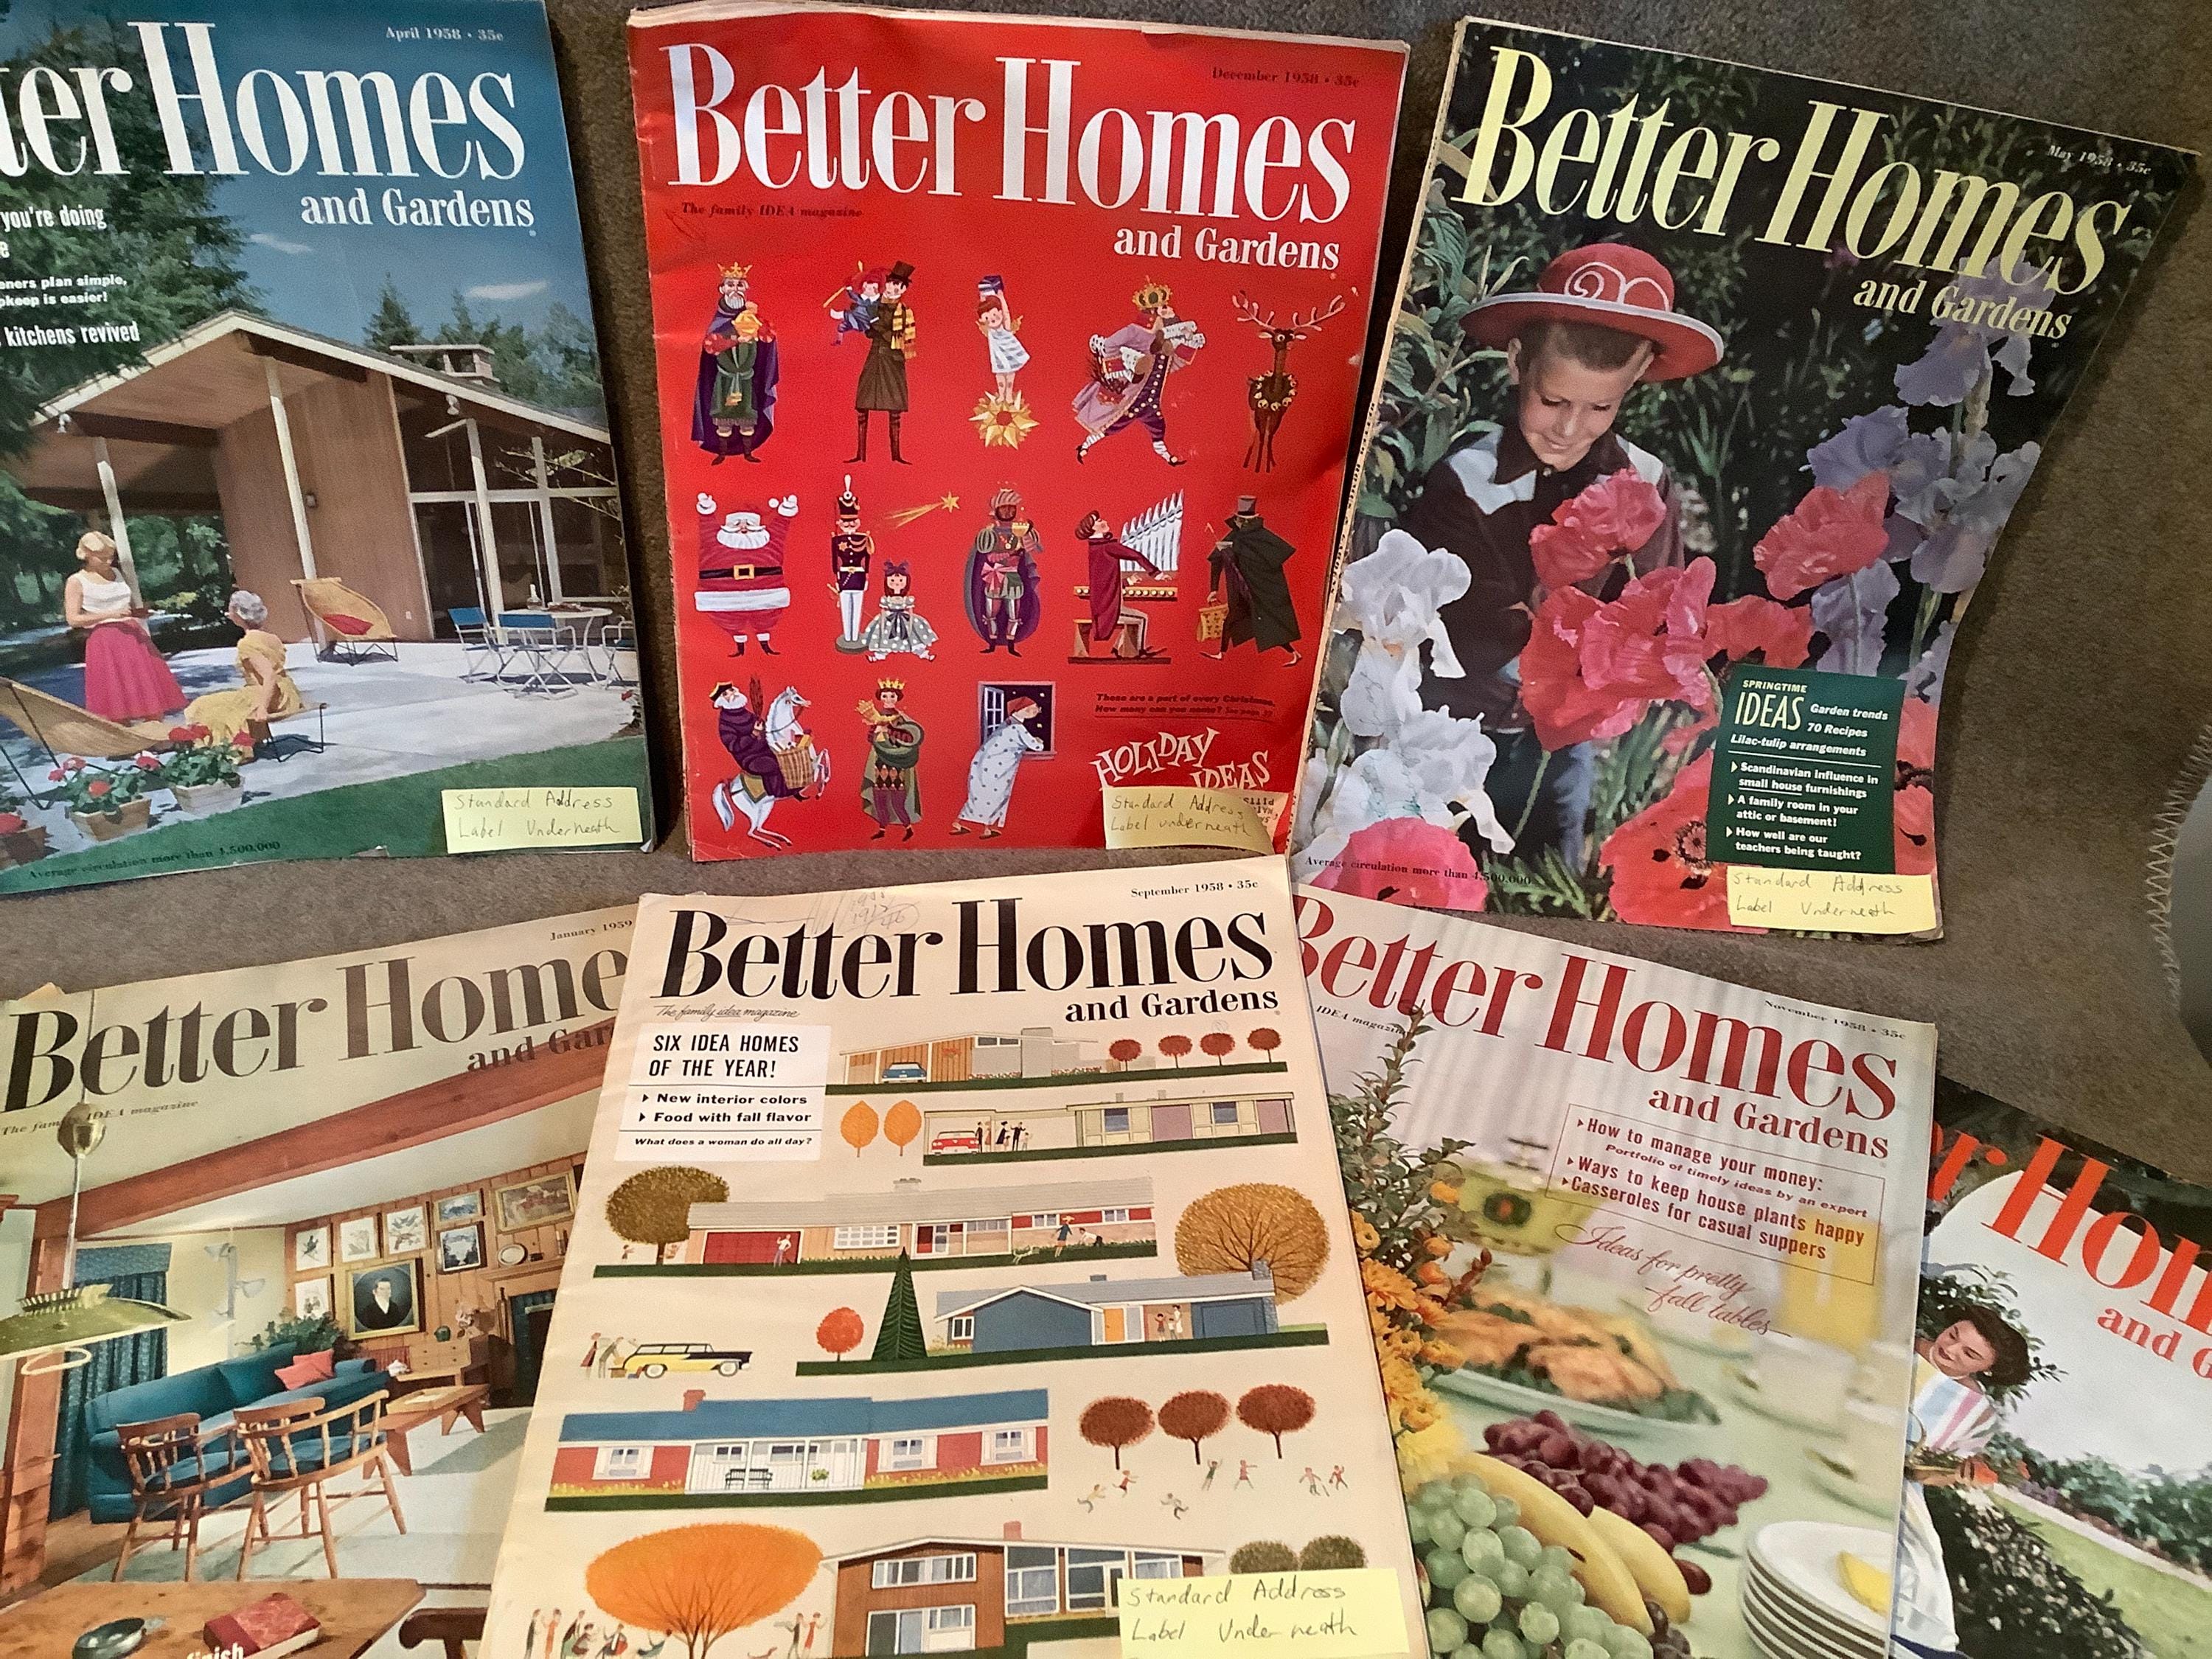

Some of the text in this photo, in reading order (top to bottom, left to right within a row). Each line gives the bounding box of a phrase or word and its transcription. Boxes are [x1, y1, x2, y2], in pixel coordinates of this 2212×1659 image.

[386, 27, 462, 42] April 1958
[1212, 67, 1279, 82] December
[127, 21, 526, 180] Homes
[659, 43, 986, 196] Better
[992, 56, 1356, 223] Homes
[1450, 46, 1781, 236] Better
[1754, 100, 2132, 295] Homes
[0, 204, 107, 232] you're doing
[301, 188, 535, 228] and Gardens
[682, 202, 863, 218] The family IDEA magazine
[1113, 225, 1340, 271] and Gardens
[41, 274, 128, 290] plan simple,
[44, 291, 108, 305] is easier!
[1853, 277, 2072, 341] and Gardens
[4, 321, 140, 347] kitchens revived
[1096, 693, 1220, 703] These every
[1742, 680, 1807, 694] SPRINGTIME
[1095, 704, 1222, 714] How many name?
[1734, 692, 1804, 731] IDEAS
[1810, 703, 1888, 720] Garden trends
[1807, 723, 1868, 738] 70 Recipes
[1731, 734, 1867, 757] Lilac-tulip arrangements
[1090, 726, 1220, 791] HOLIDAY
[1189, 750, 1271, 789] IDEAS
[1740, 762, 1879, 785] Scandinavian influence in
[454, 790, 613, 810] Standard Address
[1739, 778, 1867, 799] small house furnishings
[1111, 793, 1174, 810] Standard
[1189, 794, 1244, 819] Address
[1737, 796, 1859, 816] A family room in your
[458, 815, 620, 838] Label Underneath
[1111, 817, 1148, 832] Label
[1736, 810, 1837, 827] attic or basement!
[1736, 827, 1828, 844] How well are our
[81, 849, 213, 874] circulation more than
[1736, 841, 1862, 861] teachers being taught?
[1305, 856, 1468, 880] Average circulation more than
[1131, 883, 1224, 900] September 1958
[1733, 872, 1902, 896] Standard Address
[1736, 894, 1772, 913] Label
[550, 920, 632, 941] January 1959
[650, 897, 1273, 1000] Better Homes
[653, 1004, 800, 1022] The family idea magazine
[1065, 990, 1279, 1022] and Gardens
[1293, 894, 1896, 1121] Better Homes
[1316, 1006, 1349, 1020] IDEA
[1765, 1000, 1866, 1032] November 1958
[2, 997, 327, 1113] Better
[467, 1036, 536, 1071] and
[653, 1034, 799, 1053] SIX IDEA HOMES
[649, 1060, 776, 1078] OF THE YEAR!
[657, 1093, 807, 1105] New interior colors
[1, 1101, 198, 1135] The magazine
[654, 1112, 812, 1122] Food with fall flavor
[1649, 1087, 1888, 1159] and Gardens
[785, 1137, 812, 1147] day?
[1587, 1118, 1823, 1192] How to manage your money:
[1605, 1144, 1868, 1219] Portfolio of timely ideas by an expert
[1578, 1155, 1865, 1246] Ways to keep house plants happy
[1571, 1175, 1826, 1259] Casseroles for casual suppers
[1554, 1222, 1755, 1301] Ideas for pretty
[1644, 1285, 1711, 1312] fall
[2097, 1308, 2183, 1362] and
[1126, 1575, 1345, 1607] Standard Address
[1132, 1618, 1185, 1641] Label
